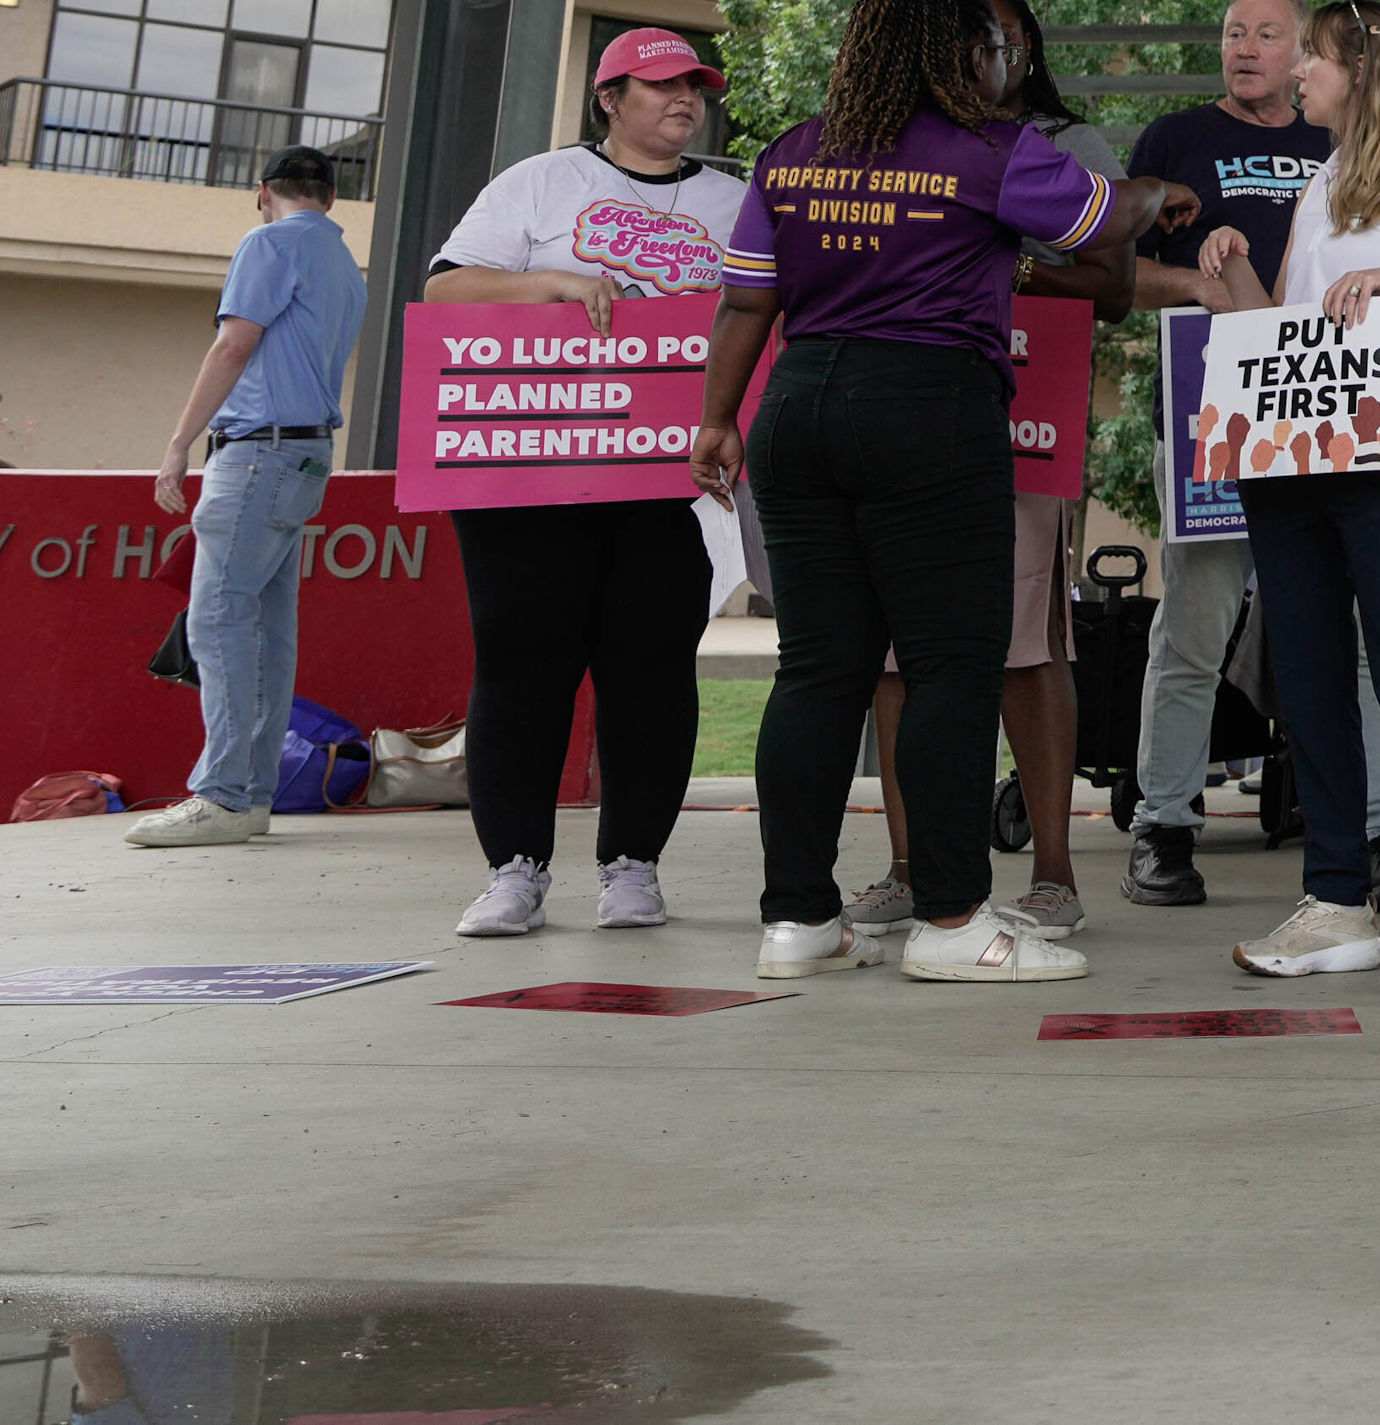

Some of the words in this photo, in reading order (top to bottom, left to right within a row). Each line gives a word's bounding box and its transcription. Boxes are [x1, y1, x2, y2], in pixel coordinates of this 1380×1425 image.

[637, 40, 672, 53] PLANNED
[639, 48, 666, 59] MAKES
[766, 167, 863, 191] PROPERTY
[868, 169, 959, 198] SERVICE
[1222, 187, 1294, 198] DEMOCRATIC
[1224, 178, 1271, 188] HARRIS
[589, 206, 697, 234] Abortion
[807, 198, 897, 225] DIVISION
[608, 230, 718, 276] Freedom
[688, 267, 718, 281] 1973
[1278, 315, 1346, 351] PUT
[442, 337, 502, 365] YO
[512, 337, 648, 364] LUCHO
[657, 335, 710, 363] PO
[438, 383, 632, 411] PLANNED
[1257, 384, 1366, 421] FIRST
[1186, 516, 1247, 529] DEMOCRA
[31, 525, 97, 578] of
[113, 525, 427, 579] HTON
